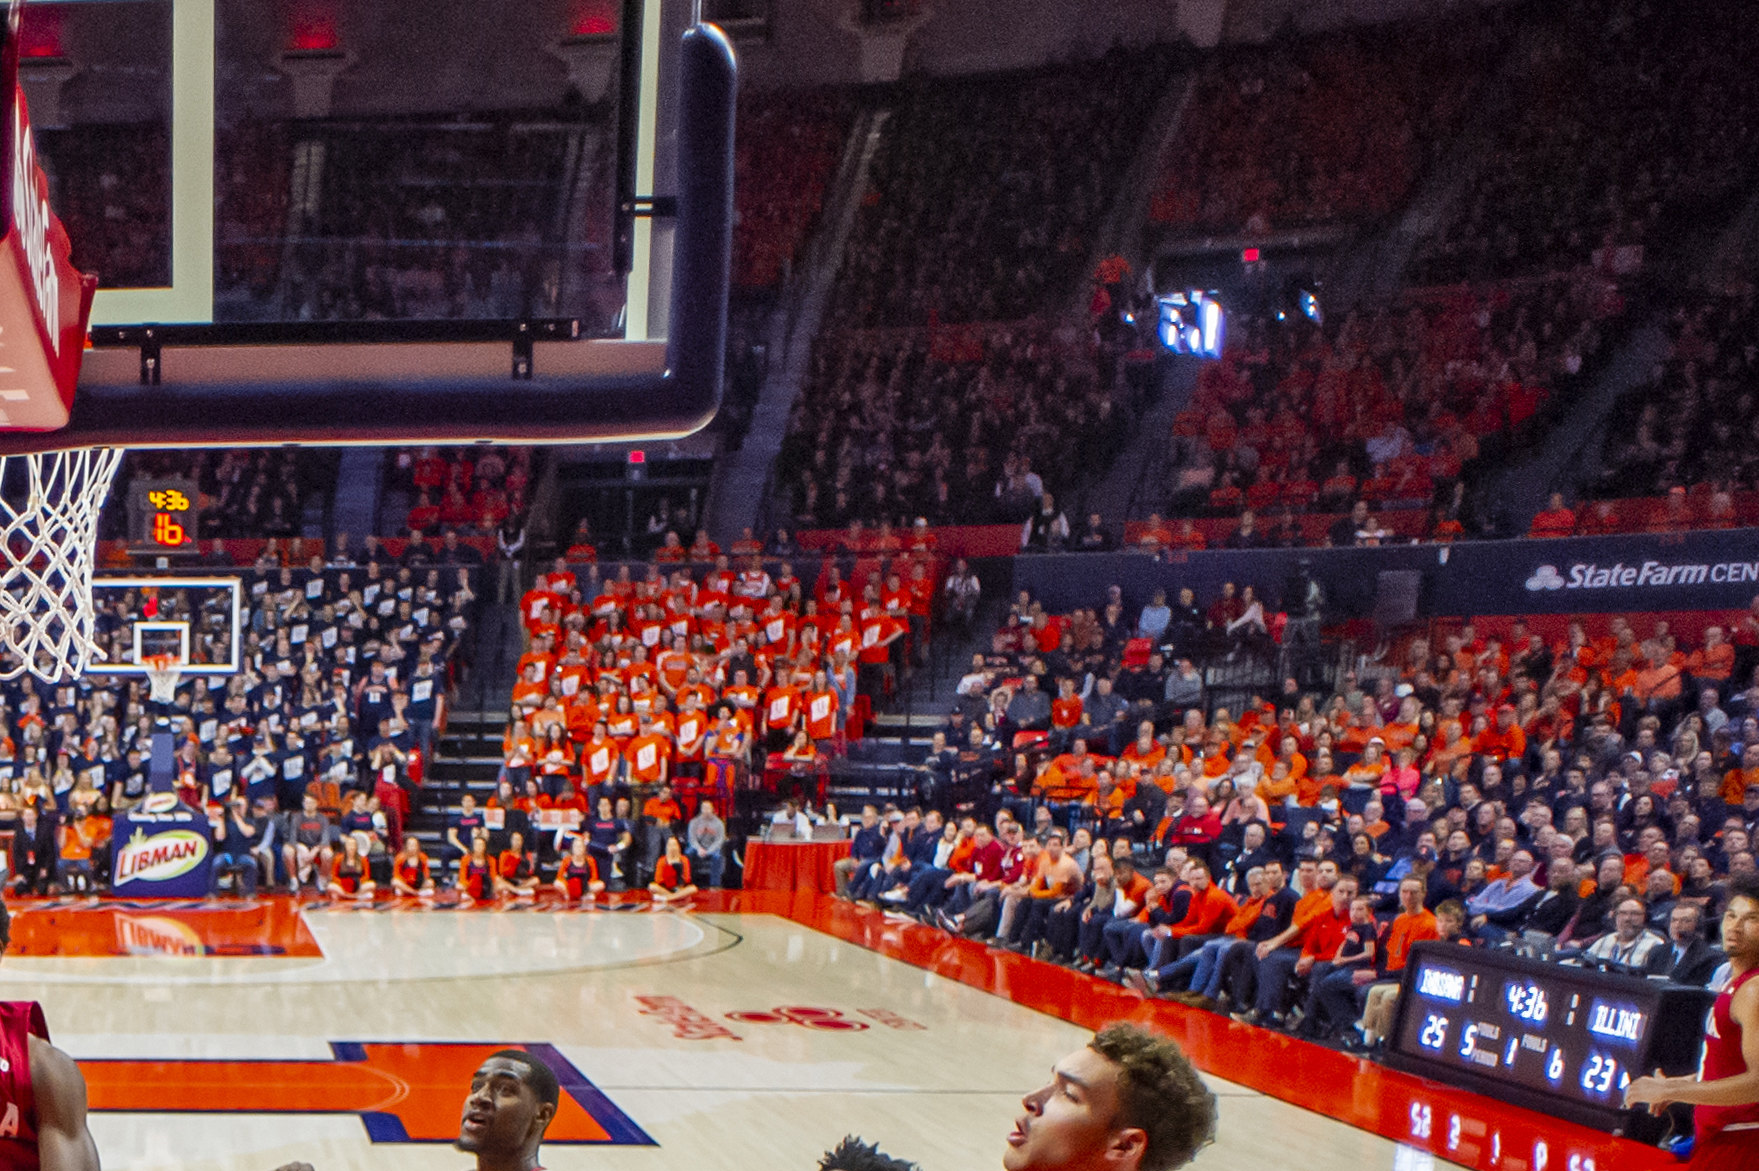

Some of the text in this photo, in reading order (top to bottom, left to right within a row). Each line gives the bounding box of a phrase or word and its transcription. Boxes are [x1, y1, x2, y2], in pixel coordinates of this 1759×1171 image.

[154, 512, 186, 548] 16
[117, 840, 197, 880] LIBMAN
[1508, 983, 1548, 1022] 4:36
[1421, 1014, 1449, 1049] 25
[1460, 1024, 1478, 1057] 5
[1548, 1048, 1565, 1080] 6
[1583, 1054, 1617, 1092] 23
